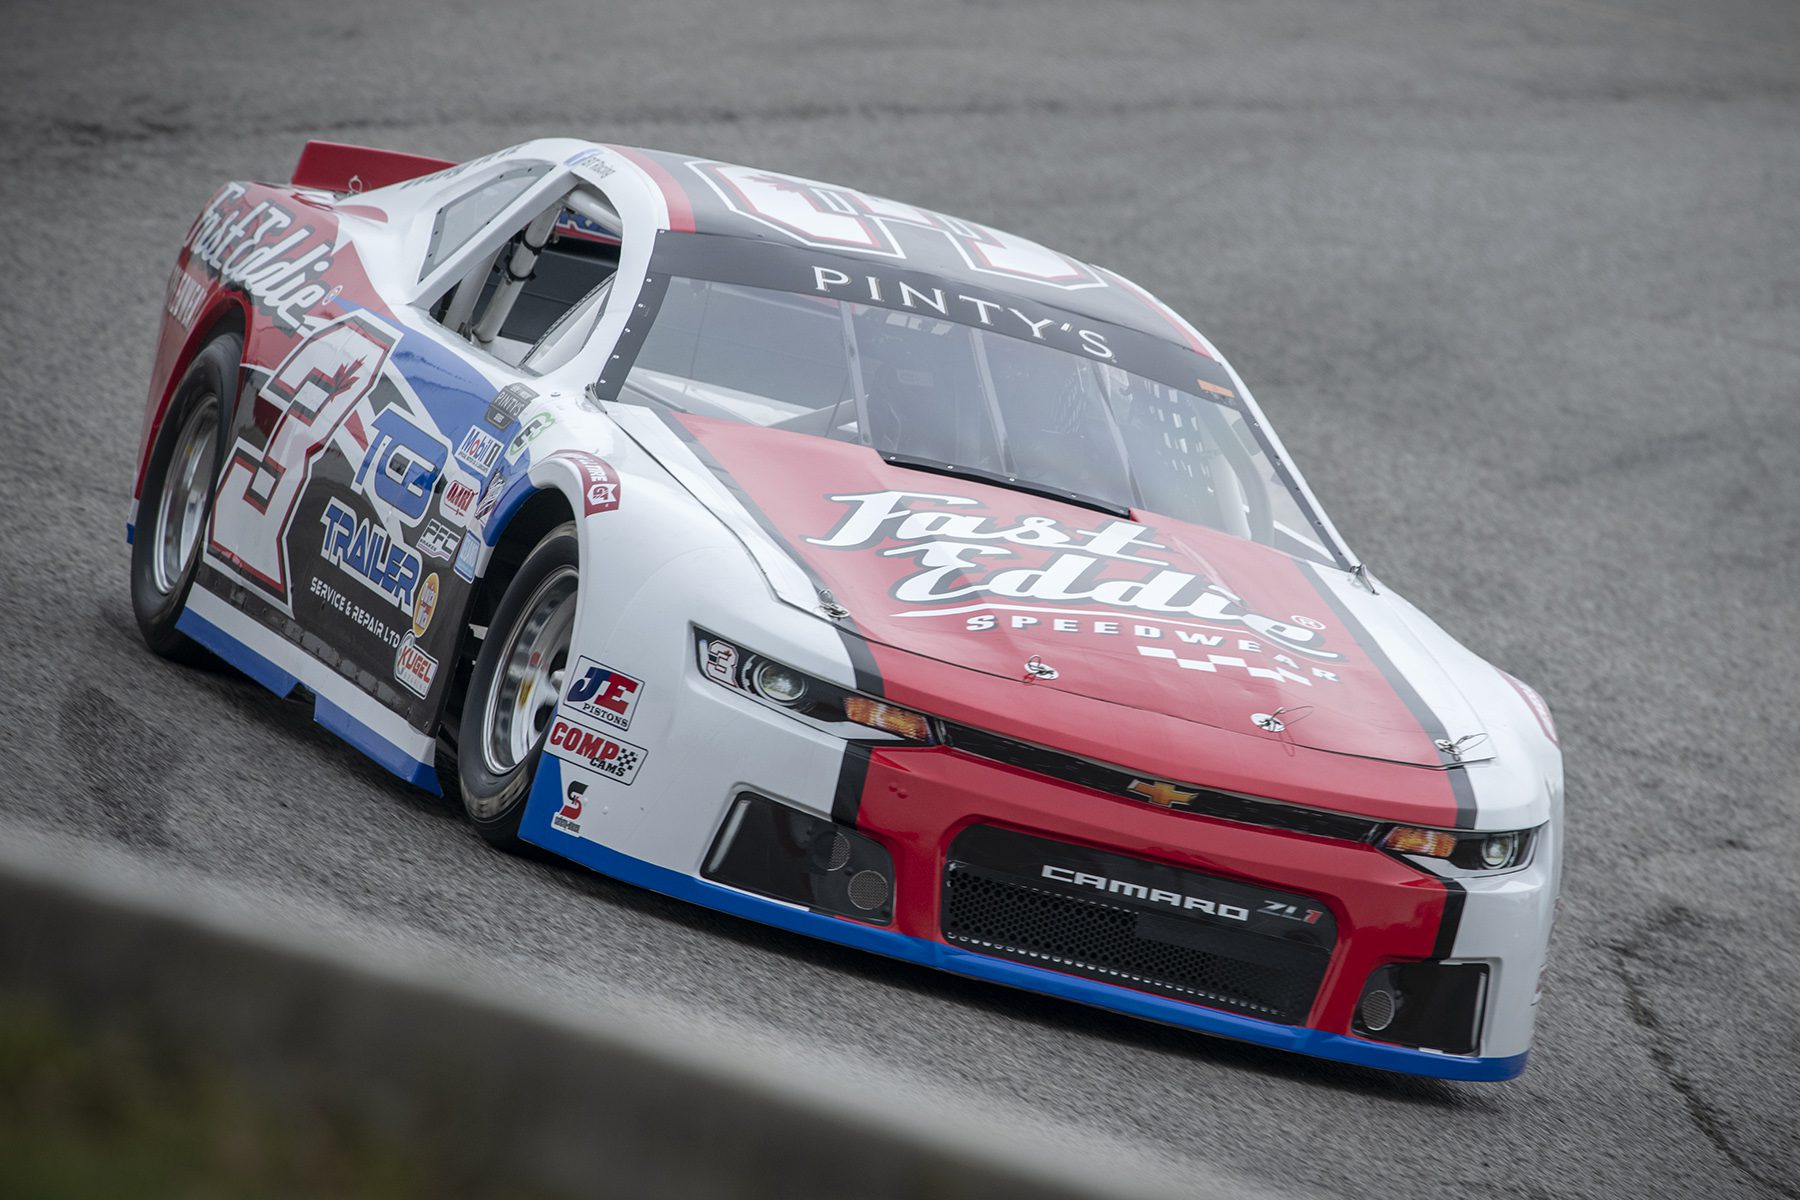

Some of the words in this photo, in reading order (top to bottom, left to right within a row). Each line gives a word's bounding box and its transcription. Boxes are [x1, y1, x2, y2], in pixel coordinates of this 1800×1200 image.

[184, 181, 269, 271] Fast
[220, 206, 331, 339] Eddie
[811, 265, 1117, 363] PINTY'S
[204, 310, 404, 618] 3
[461, 428, 494, 463] Mobil
[485, 443, 501, 467] 1
[322, 500, 422, 613] TRAILER
[423, 520, 461, 555] PFC
[806, 490, 1169, 566] Fast
[310, 577, 345, 611] SERVICE
[345, 601, 352, 616] &
[351, 605, 385, 637] REPAIR
[383, 627, 401, 650] LTD
[884, 540, 1338, 658] Eddie
[398, 645, 433, 684] KUGEL
[706, 640, 739, 688] 3
[966, 614, 1341, 682] SPEEDWEAR
[566, 666, 639, 716] JE
[582, 703, 629, 728] PISTONS
[549, 721, 621, 762] COMP
[589, 756, 627, 778] CAMS
[1041, 864, 1250, 922] CAMARO
[1256, 900, 1323, 925] ZL1
